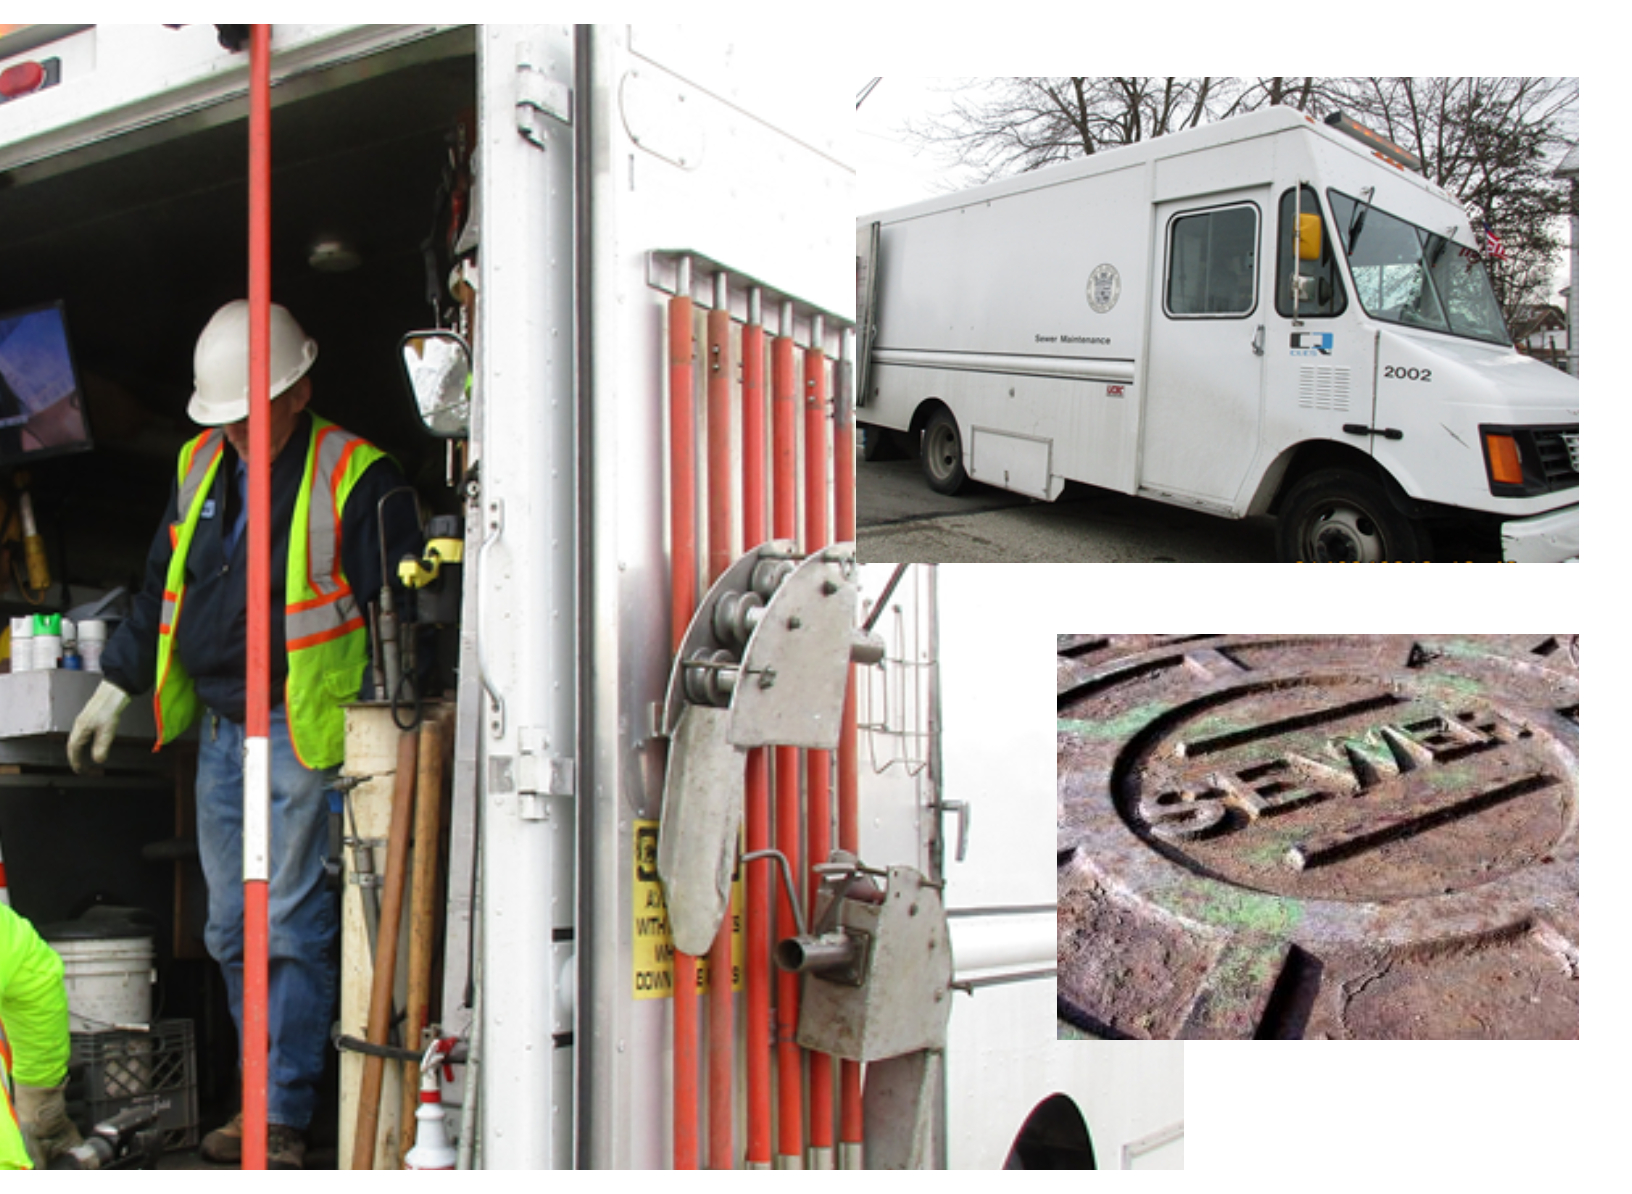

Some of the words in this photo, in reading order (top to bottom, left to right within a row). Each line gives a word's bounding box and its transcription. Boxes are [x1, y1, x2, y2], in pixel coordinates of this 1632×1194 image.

[1034, 333, 1058, 343] Sewer
[1060, 335, 1111, 345] Maintenance
[1384, 365, 1432, 382] 2002
[1139, 704, 1534, 842] SEWER
